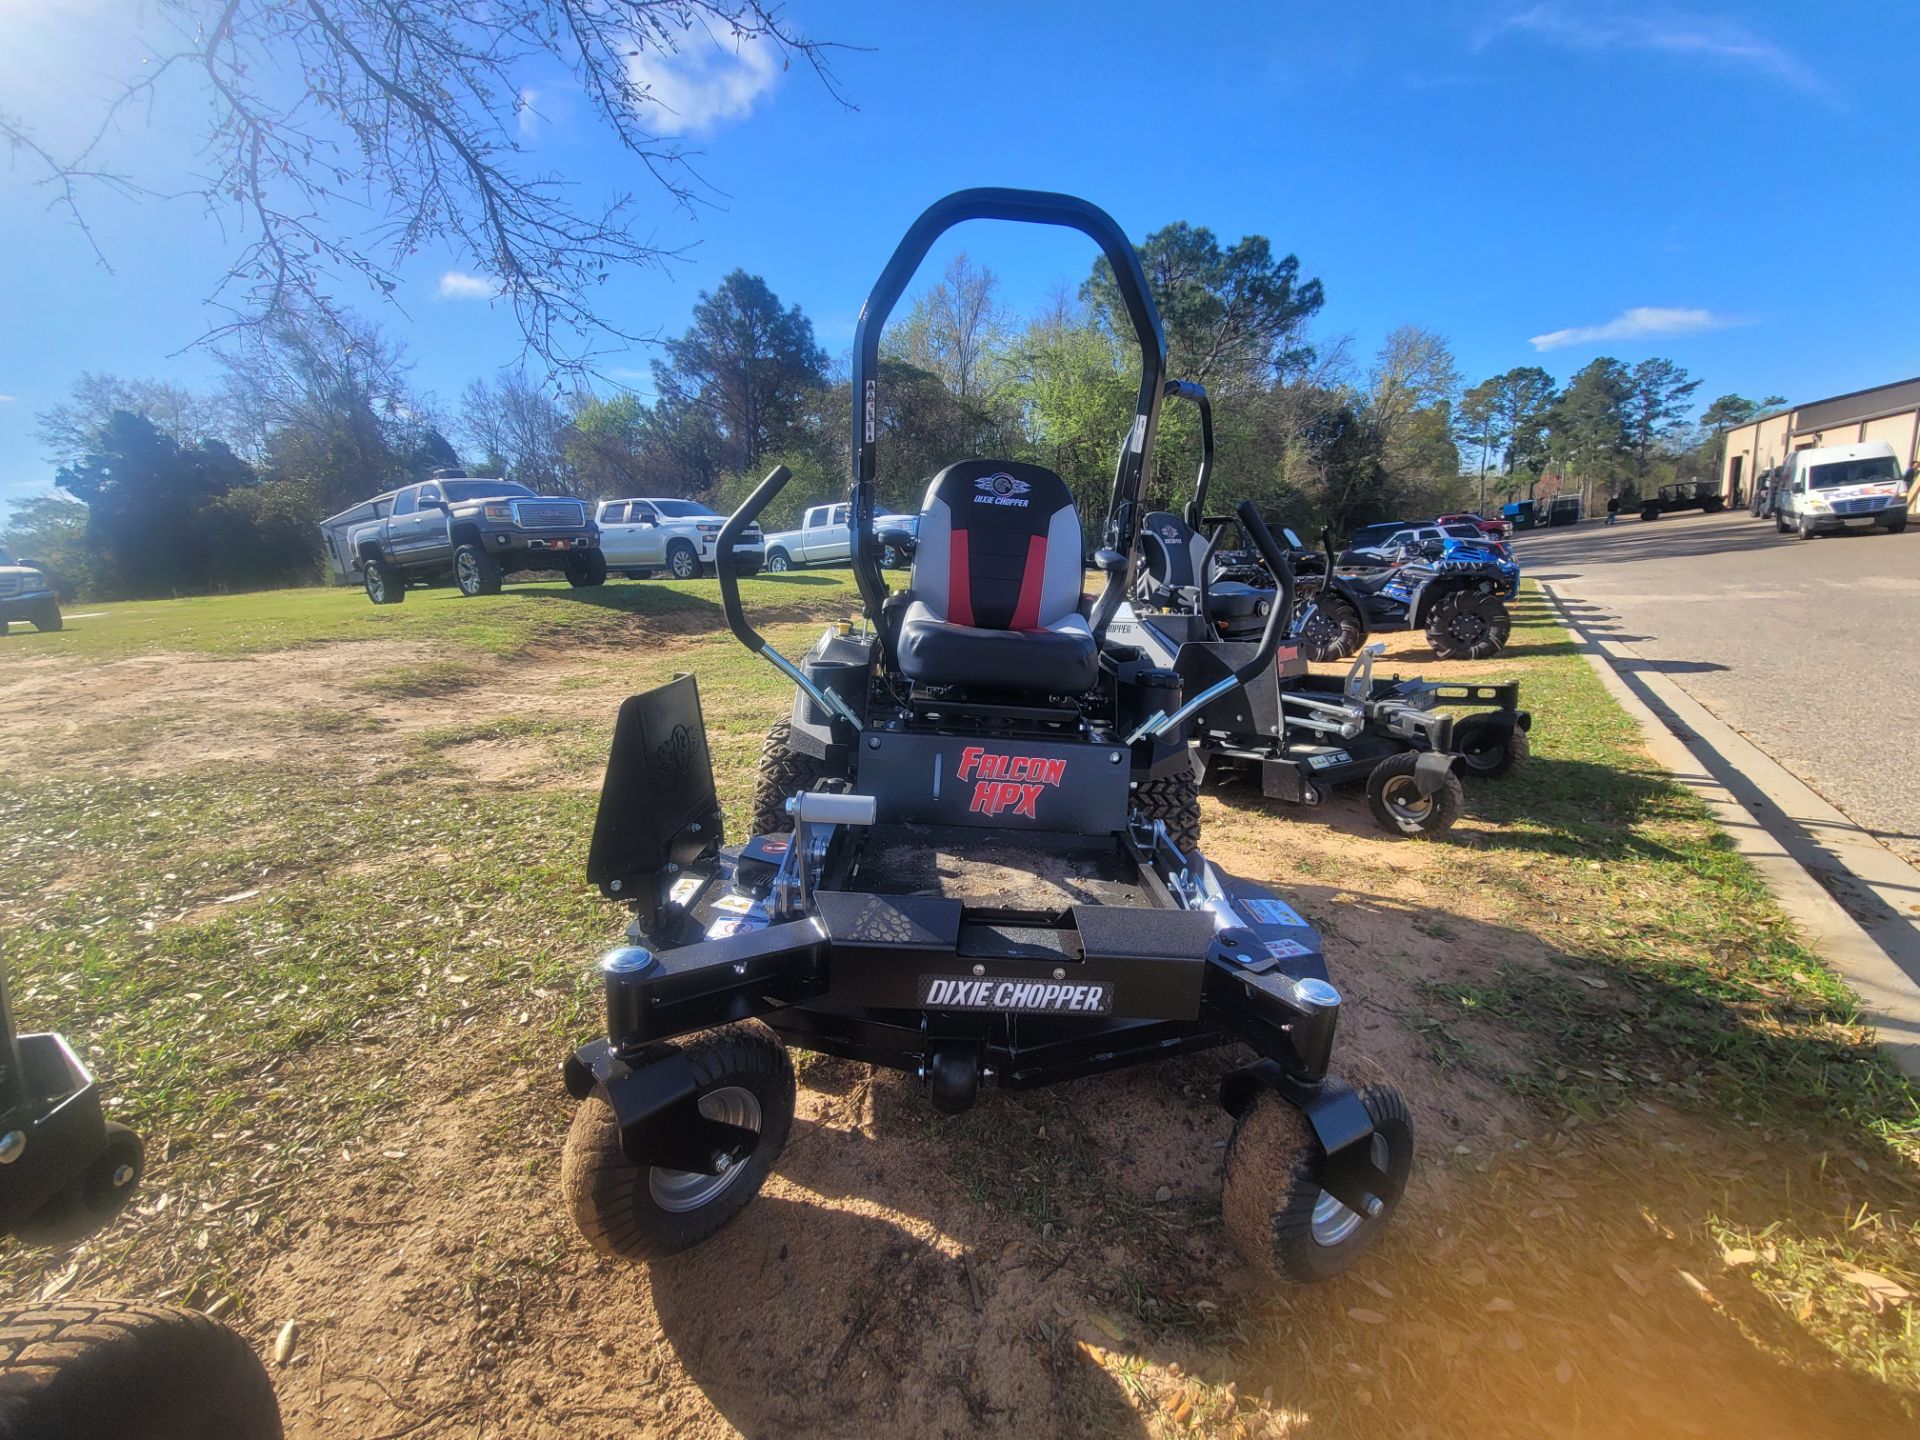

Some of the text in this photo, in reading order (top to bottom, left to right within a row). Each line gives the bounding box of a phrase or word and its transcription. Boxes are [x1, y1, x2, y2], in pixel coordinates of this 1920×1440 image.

[1823, 487, 1893, 500] FedEx
[973, 494, 1029, 508] DIXIE CHOPPER
[1107, 624, 1132, 634] HOPPER
[969, 781, 1044, 819] HPX
[926, 979, 1103, 1011] DIXIE CHOPPER
